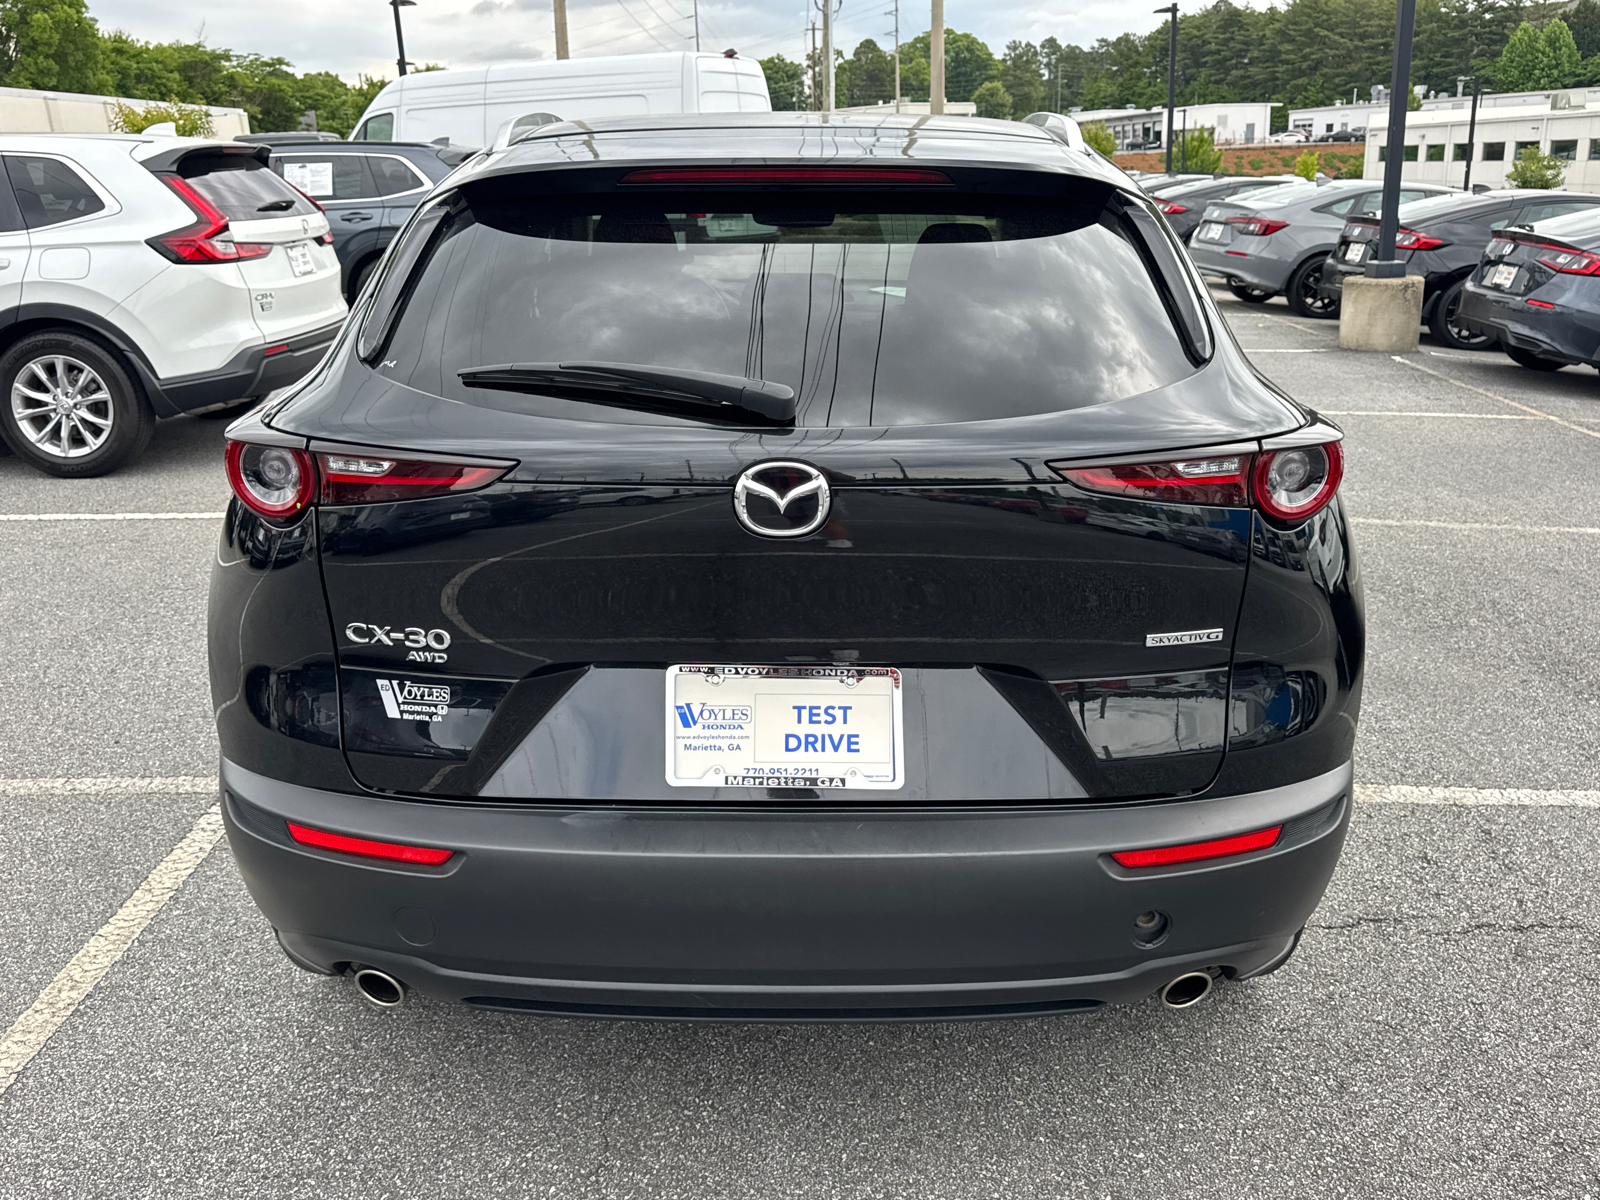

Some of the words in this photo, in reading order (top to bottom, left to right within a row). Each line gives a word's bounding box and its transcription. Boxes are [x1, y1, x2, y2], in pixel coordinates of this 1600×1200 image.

[345, 622, 451, 650] CX-30
[406, 650, 448, 663] AWD
[380, 684, 390, 692] ED
[391, 680, 448, 703] VOYLES
[400, 704, 437, 713] HONDA
[685, 702, 749, 726] VOYLES
[792, 705, 852, 725] TEST
[402, 713, 431, 722] Marietta,
[684, 743, 724, 752] Marietta,
[727, 743, 742, 751] GA
[784, 733, 860, 753] DRIVE
[743, 767, 819, 776] 770-951-2211
[727, 776, 810, 787] Marietta,
[817, 777, 844, 788] GA
